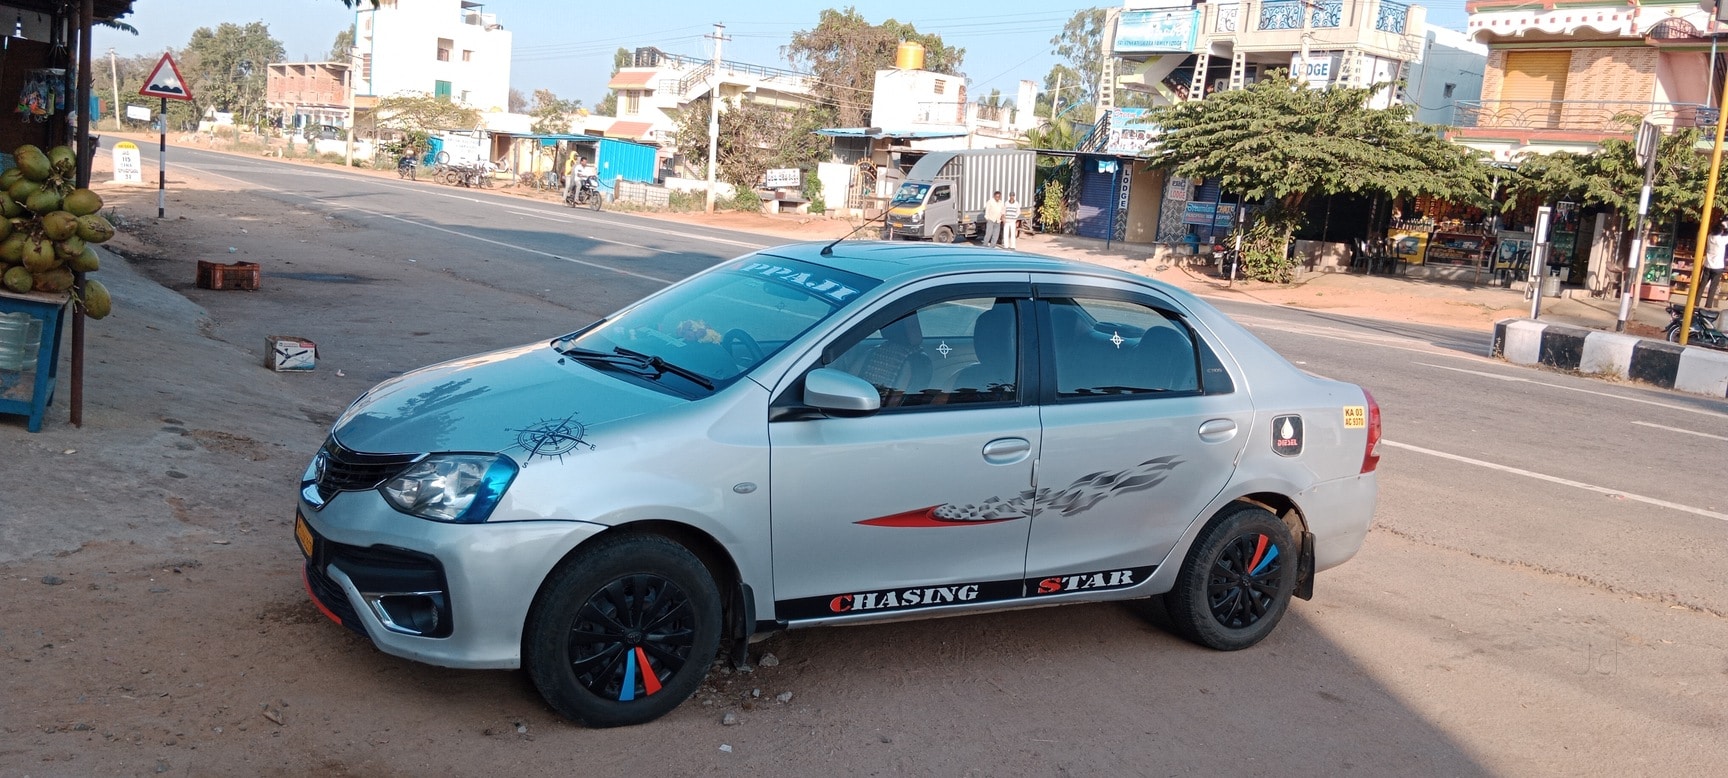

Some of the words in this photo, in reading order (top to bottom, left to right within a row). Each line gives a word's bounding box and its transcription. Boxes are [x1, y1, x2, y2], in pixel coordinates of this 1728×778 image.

[1292, 63, 1328, 76] LDGE
[1121, 169, 1130, 207] LODGE
[1170, 190, 1186, 199] LODGE
[1345, 409, 1354, 417] KA
[1345, 418, 1352, 426] AC
[1277, 439, 1298, 447] DIESEL
[829, 584, 979, 613] CHASING
[1037, 570, 1134, 594] STAR
